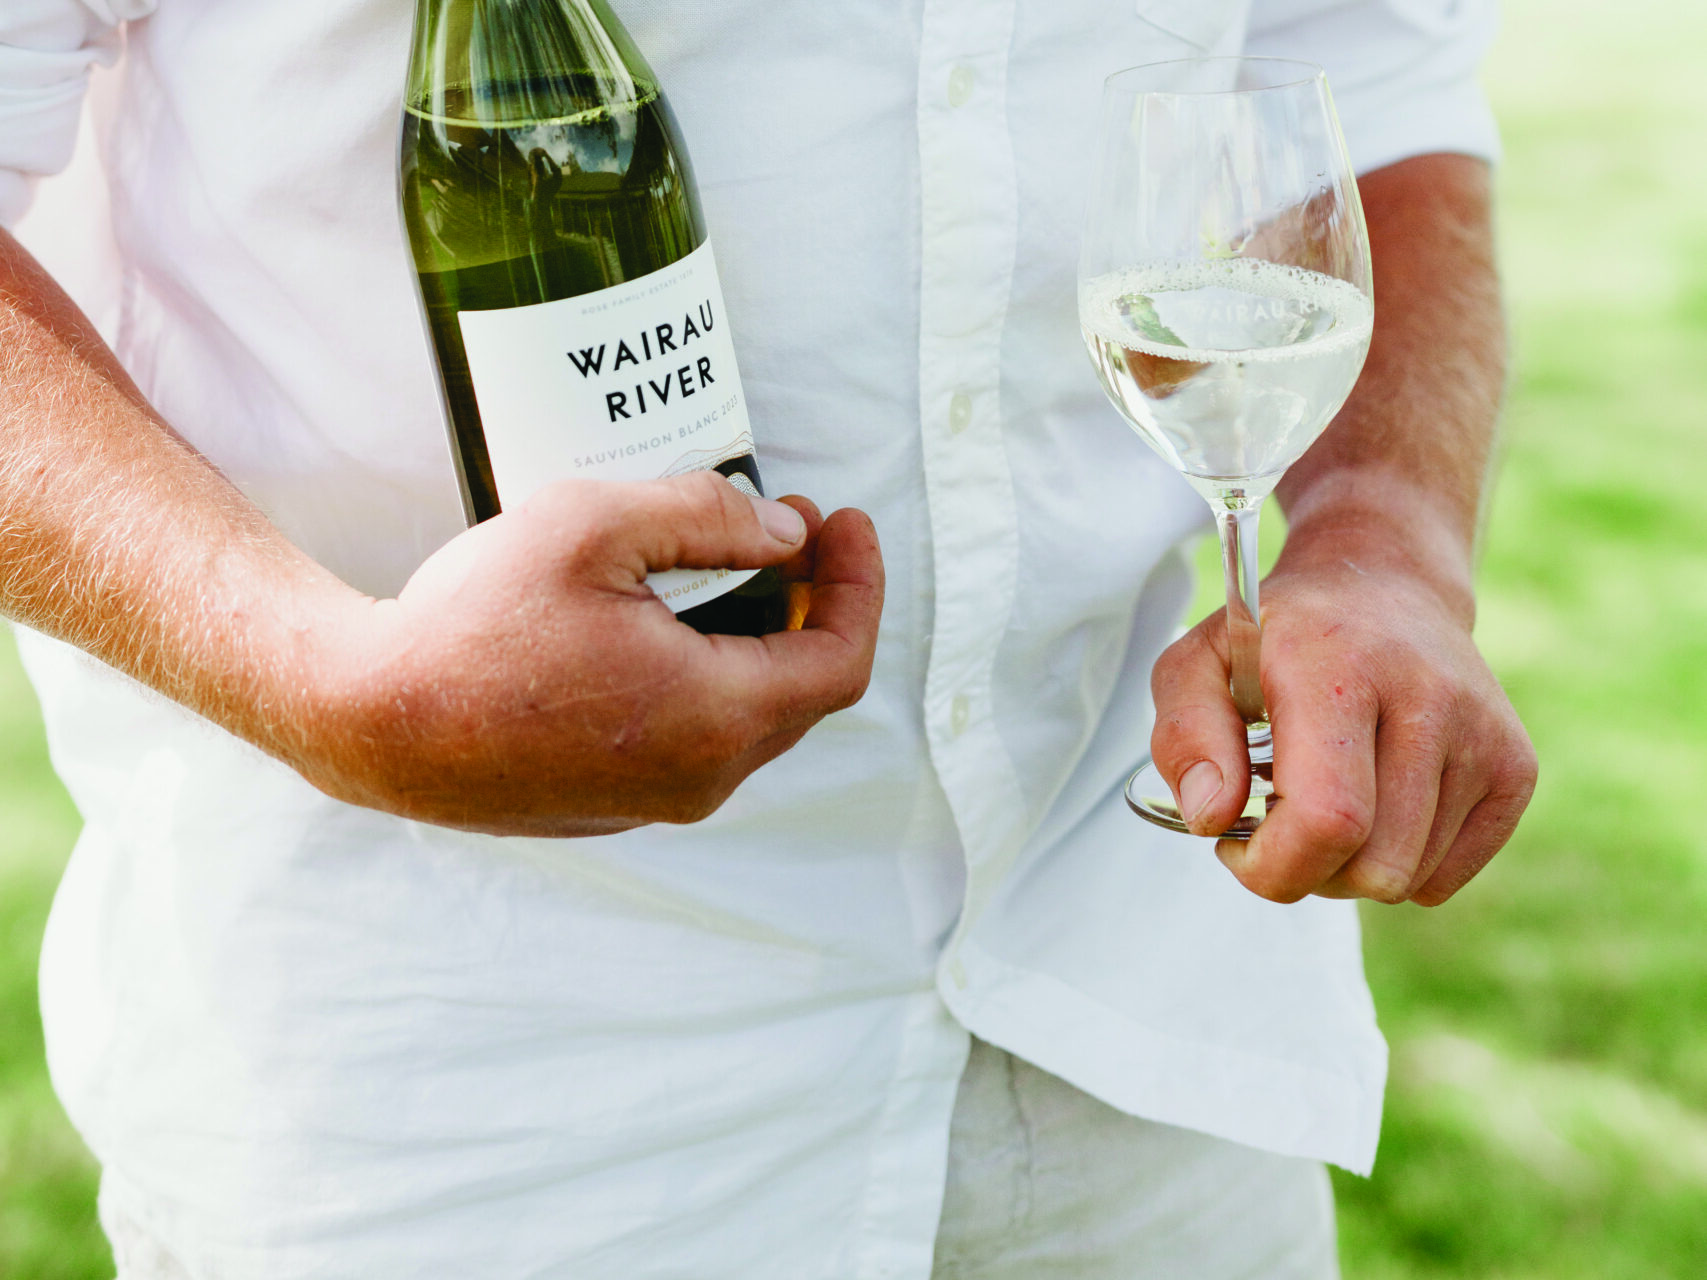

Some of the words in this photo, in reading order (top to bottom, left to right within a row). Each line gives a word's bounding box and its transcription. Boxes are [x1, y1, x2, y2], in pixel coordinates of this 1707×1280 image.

[612, 291, 645, 307] FAMILY
[649, 277, 677, 295] ESTATE
[566, 299, 714, 379] WAIRAU
[606, 356, 715, 423] RIVER
[573, 431, 673, 468] SAUVIGNON
[678, 409, 719, 438] BLANC
